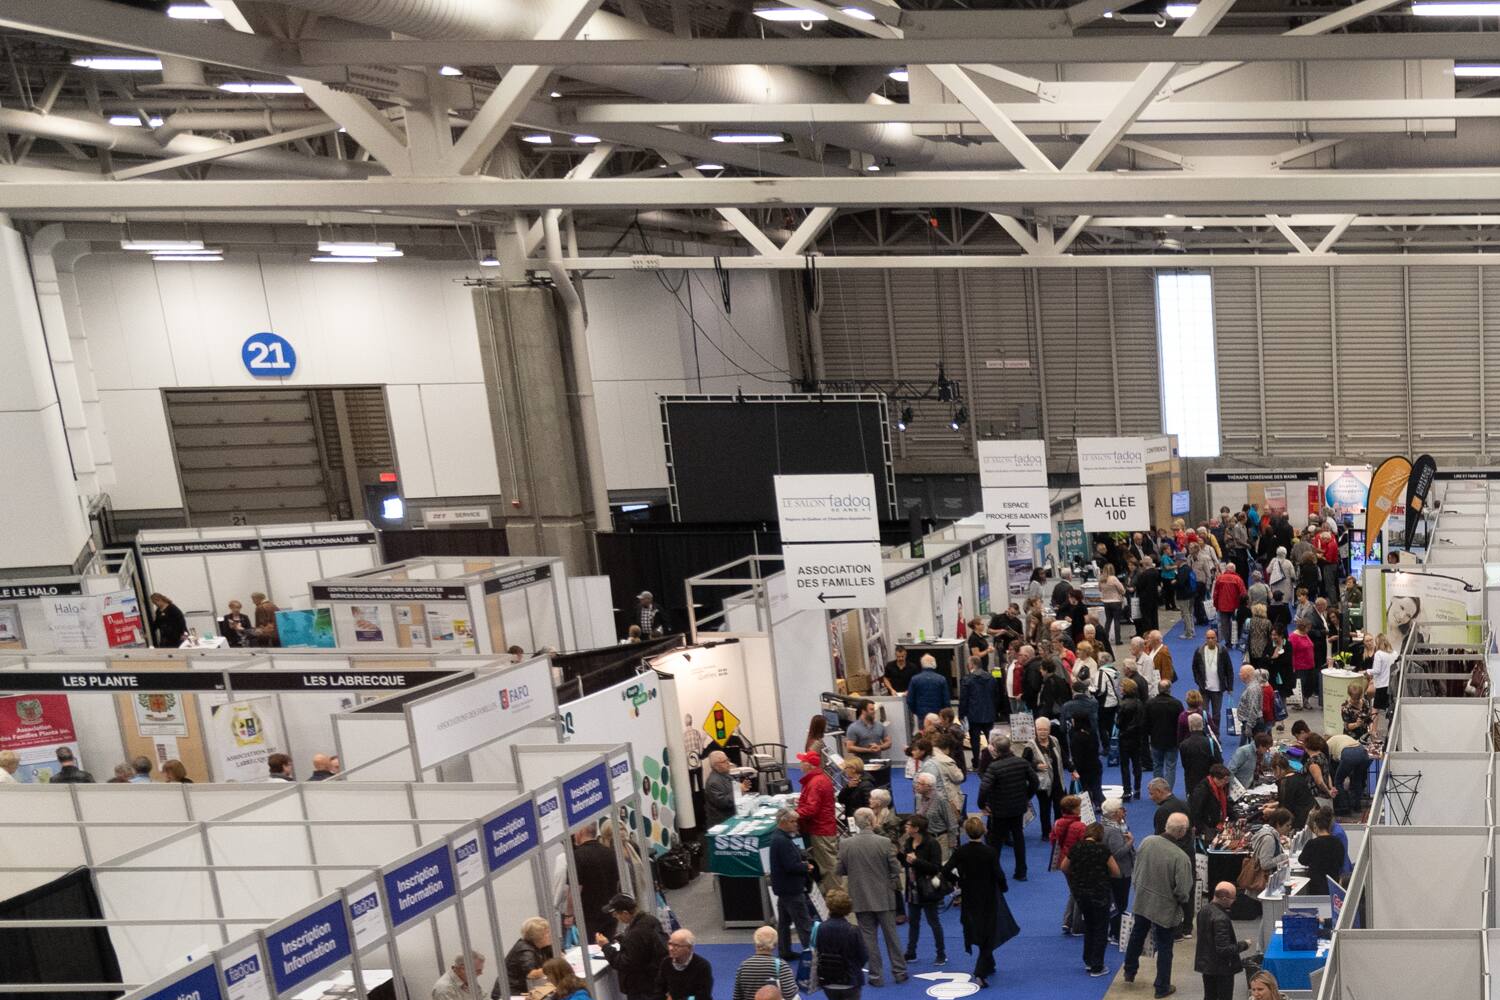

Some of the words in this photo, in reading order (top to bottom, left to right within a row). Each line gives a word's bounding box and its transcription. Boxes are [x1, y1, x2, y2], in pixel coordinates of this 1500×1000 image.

[248, 343, 290, 368] 21
[1014, 454, 1041, 466] fadoq
[1113, 450, 1142, 462] fadoq
[829, 494, 871, 512] fadoq
[1094, 493, 1136, 508] ALLÉE
[1106, 510, 1127, 521] 100
[142, 544, 183, 552] RENCONTRE
[185, 542, 242, 551] PERSONNALISÉE
[263, 540, 303, 548] RENCONTRE
[304, 536, 360, 546] PERSONNALISÉE
[798, 565, 871, 575] ASSOCIATION
[797, 579, 819, 588] DES
[822, 577, 875, 587] FAMILLES
[13, 588, 26, 597] LE
[28, 586, 58, 595] HALO
[54, 603, 80, 614] Halo
[63, 677, 87, 687] LES
[90, 676, 138, 686] PLANTE
[304, 677, 327, 686] LES
[330, 675, 406, 686] LABRECQUE
[570, 777, 600, 799] Inscription
[572, 792, 603, 815] Information
[493, 816, 525, 841] Inscription
[494, 830, 529, 858] Information
[397, 864, 439, 891] Inscription
[399, 880, 444, 910] Information
[282, 921, 331, 954] Inscription
[284, 938, 336, 974] Information
